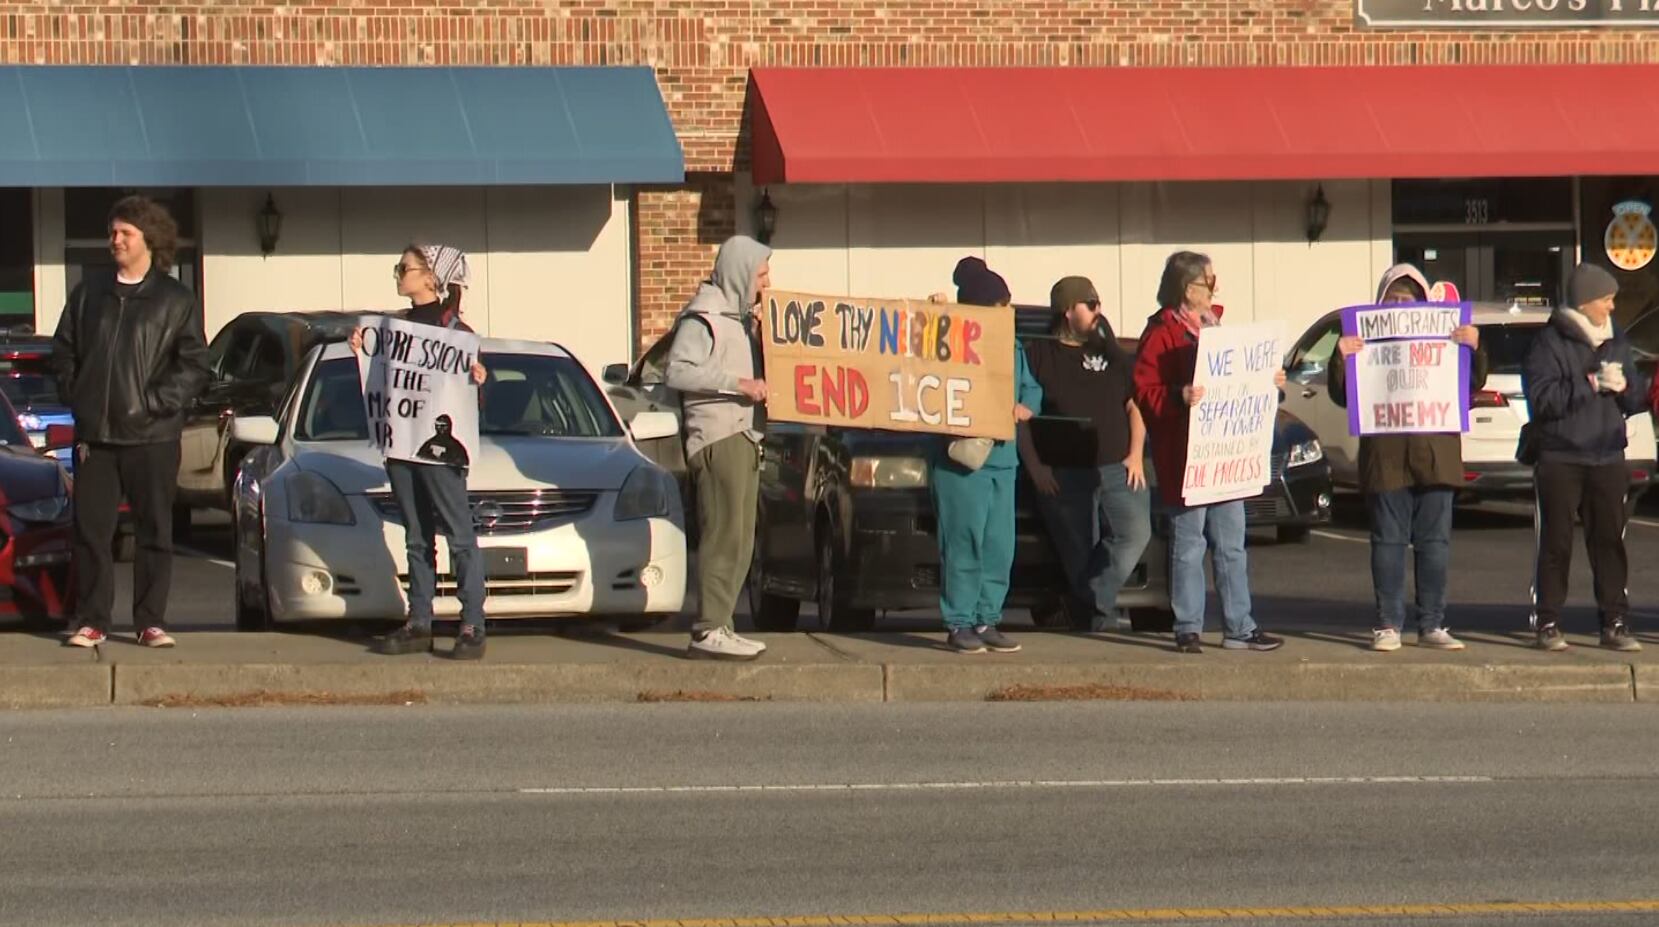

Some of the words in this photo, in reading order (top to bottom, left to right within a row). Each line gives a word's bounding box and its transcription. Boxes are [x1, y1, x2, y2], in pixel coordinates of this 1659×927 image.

[1465, 199, 1488, 224] 3513
[769, 297, 826, 347] LOVE
[835, 302, 875, 352] THY
[879, 304, 982, 366] NEIGHBOR
[1360, 310, 1459, 338] IMMIGRANTS
[1207, 348, 1234, 377] WE
[1244, 339, 1280, 373] WERE
[1368, 345, 1401, 366] ARE
[1409, 342, 1447, 368] NOT
[391, 368, 432, 393] THE
[1386, 369, 1428, 393] OUR
[398, 398, 426, 418] OF
[794, 364, 869, 420] END
[889, 371, 972, 428] ICE
[1198, 393, 1273, 423] SEPARATION
[1223, 414, 1265, 437] POWER
[1373, 401, 1451, 429] ENEMY
[1185, 461, 1208, 490] DUE
[1212, 454, 1263, 487] PROCESS
